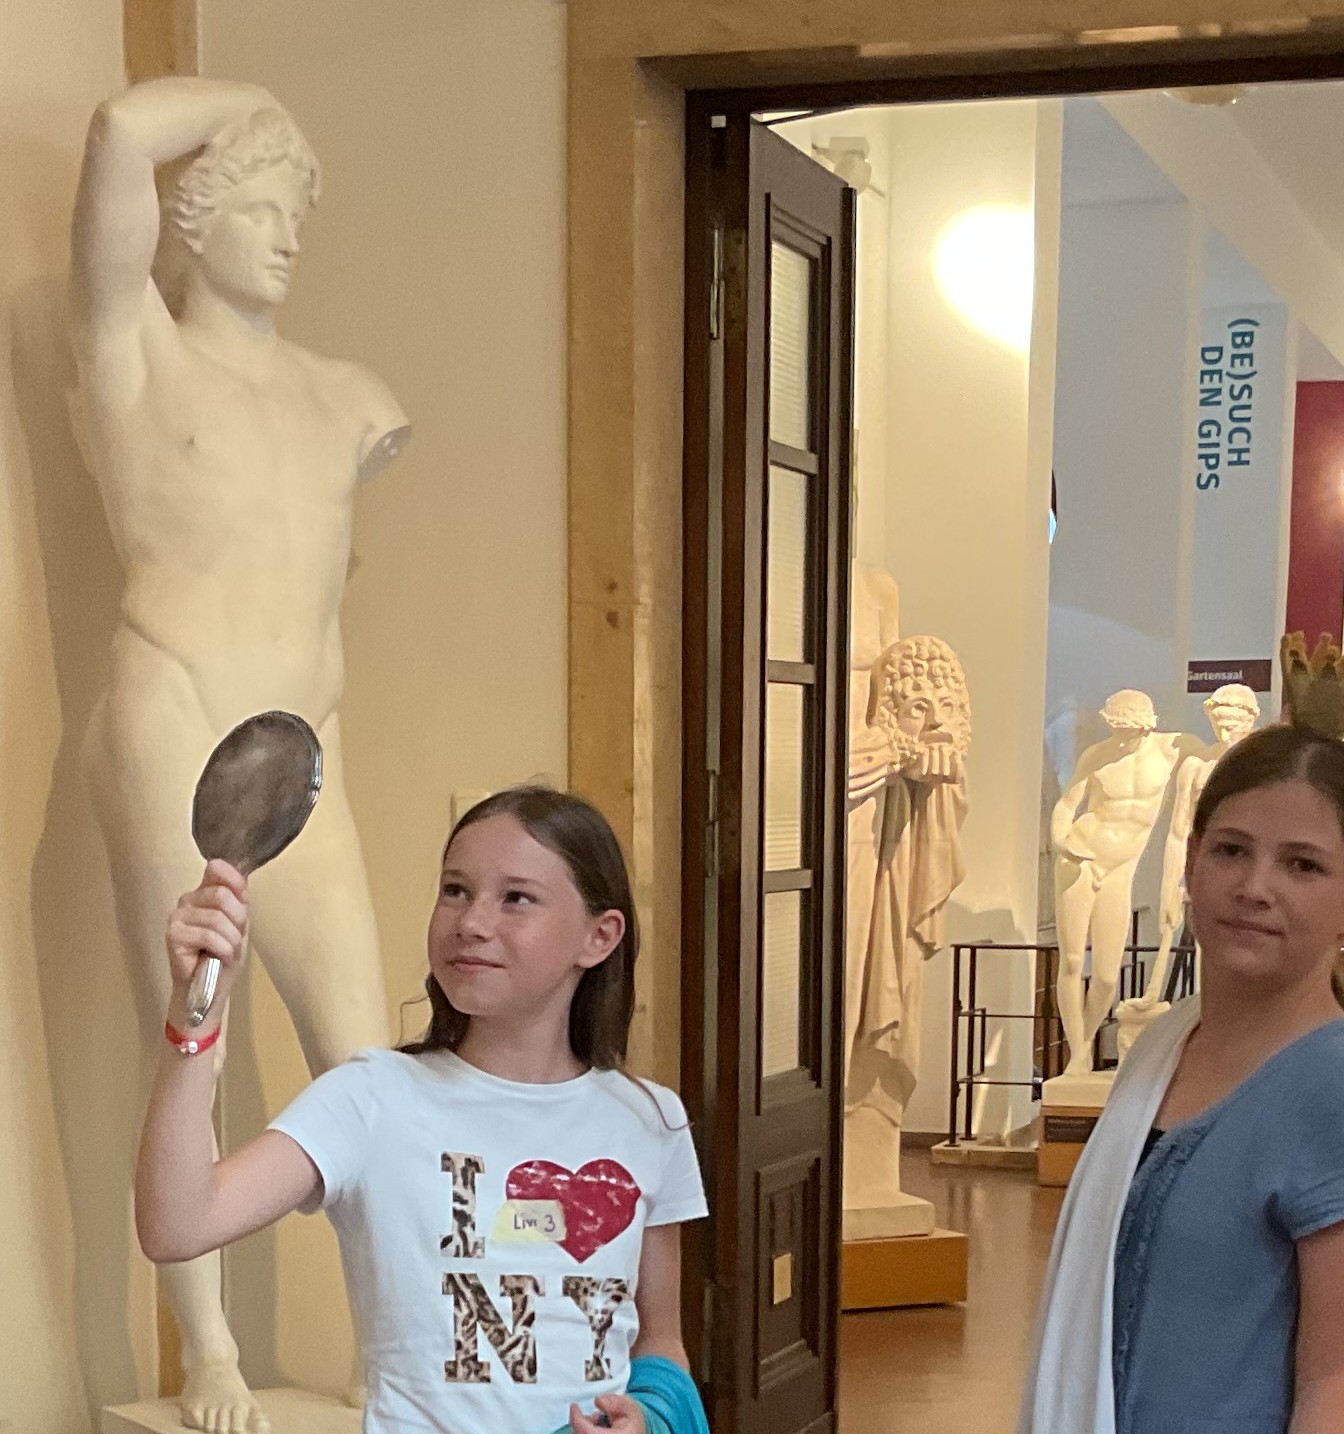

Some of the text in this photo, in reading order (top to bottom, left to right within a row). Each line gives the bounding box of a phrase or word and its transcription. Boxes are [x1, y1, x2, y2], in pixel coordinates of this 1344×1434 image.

[1196, 345, 1224, 491] DEN GIPS
[1225, 318, 1260, 467] (BE)SUCH
[1187, 669, 1244, 682] Gartensaal
[440, 1151, 486, 1259] I
[544, 1213, 556, 1233] 3
[441, 1272, 630, 1384] NY
